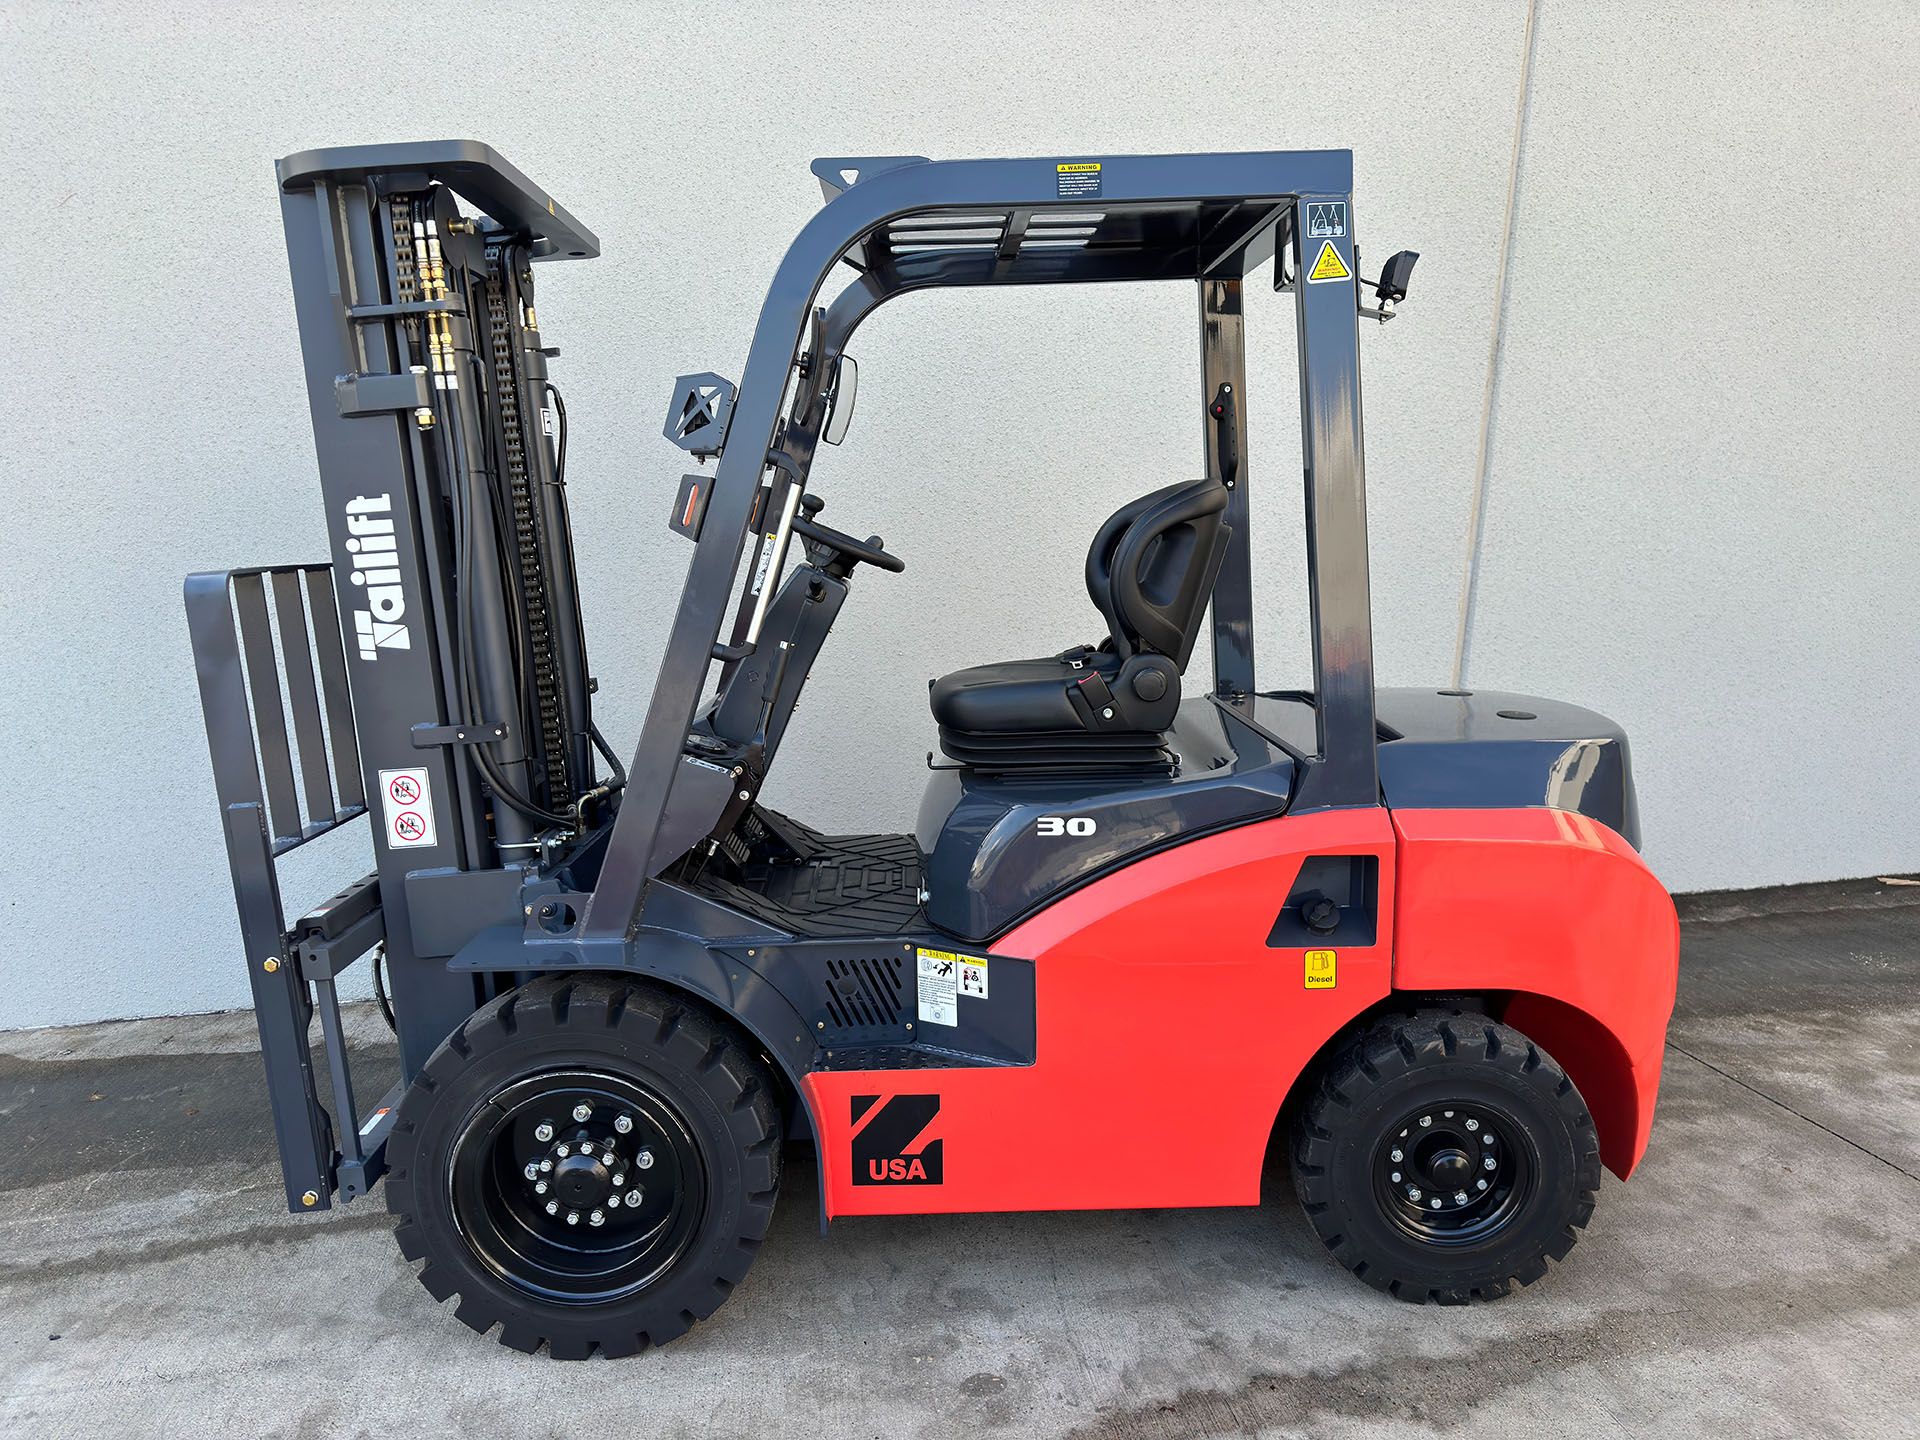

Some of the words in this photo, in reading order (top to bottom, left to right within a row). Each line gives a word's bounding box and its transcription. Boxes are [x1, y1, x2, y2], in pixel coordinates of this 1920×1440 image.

[345, 493, 411, 661] Tailift
[1037, 817, 1097, 836] 30
[869, 1158, 928, 1181] USA
